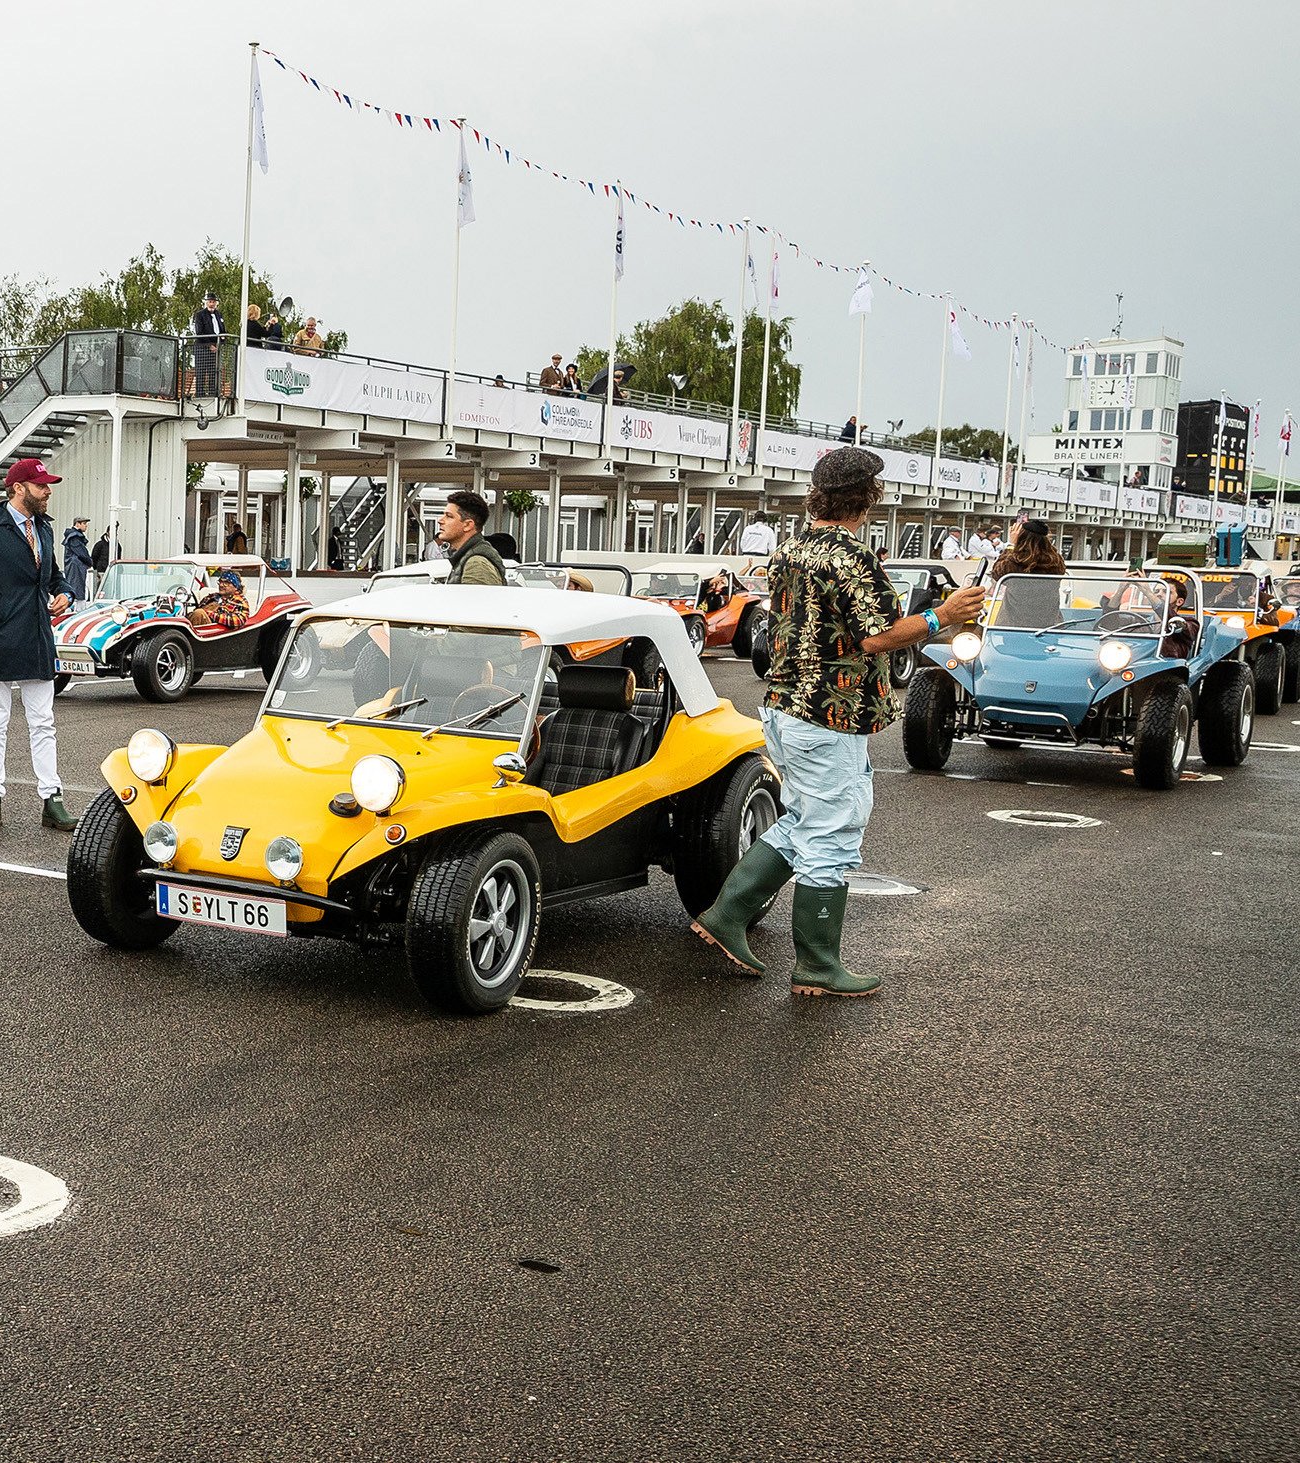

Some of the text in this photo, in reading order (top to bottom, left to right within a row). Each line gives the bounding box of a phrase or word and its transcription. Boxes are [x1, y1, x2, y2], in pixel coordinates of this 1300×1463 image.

[362, 383, 433, 405] RALPH LAUREN
[551, 404, 581, 417] COLUMBIA
[459, 412, 501, 426] EDMISTON
[552, 415, 593, 430] THREADNEEDLE
[633, 419, 653, 440] UBS
[445, 443, 453, 456] 2
[1055, 438, 1123, 450] MINTEX
[766, 445, 797, 456] ALPINE
[1054, 452, 1086, 460] BRAE
[529, 453, 536, 465] 3
[603, 461, 611, 473] 4
[669, 468, 676, 479] 5
[728, 475, 735, 485] 6
[894, 494, 900, 502] 9
[926, 498, 937, 506] 10
[963, 501, 972, 510] 11
[994, 505, 1004, 513] 12
[62, 661, 90, 673] S CAL 1
[161, 902, 167, 910] A
[178, 892, 269, 928] S YLT 66
